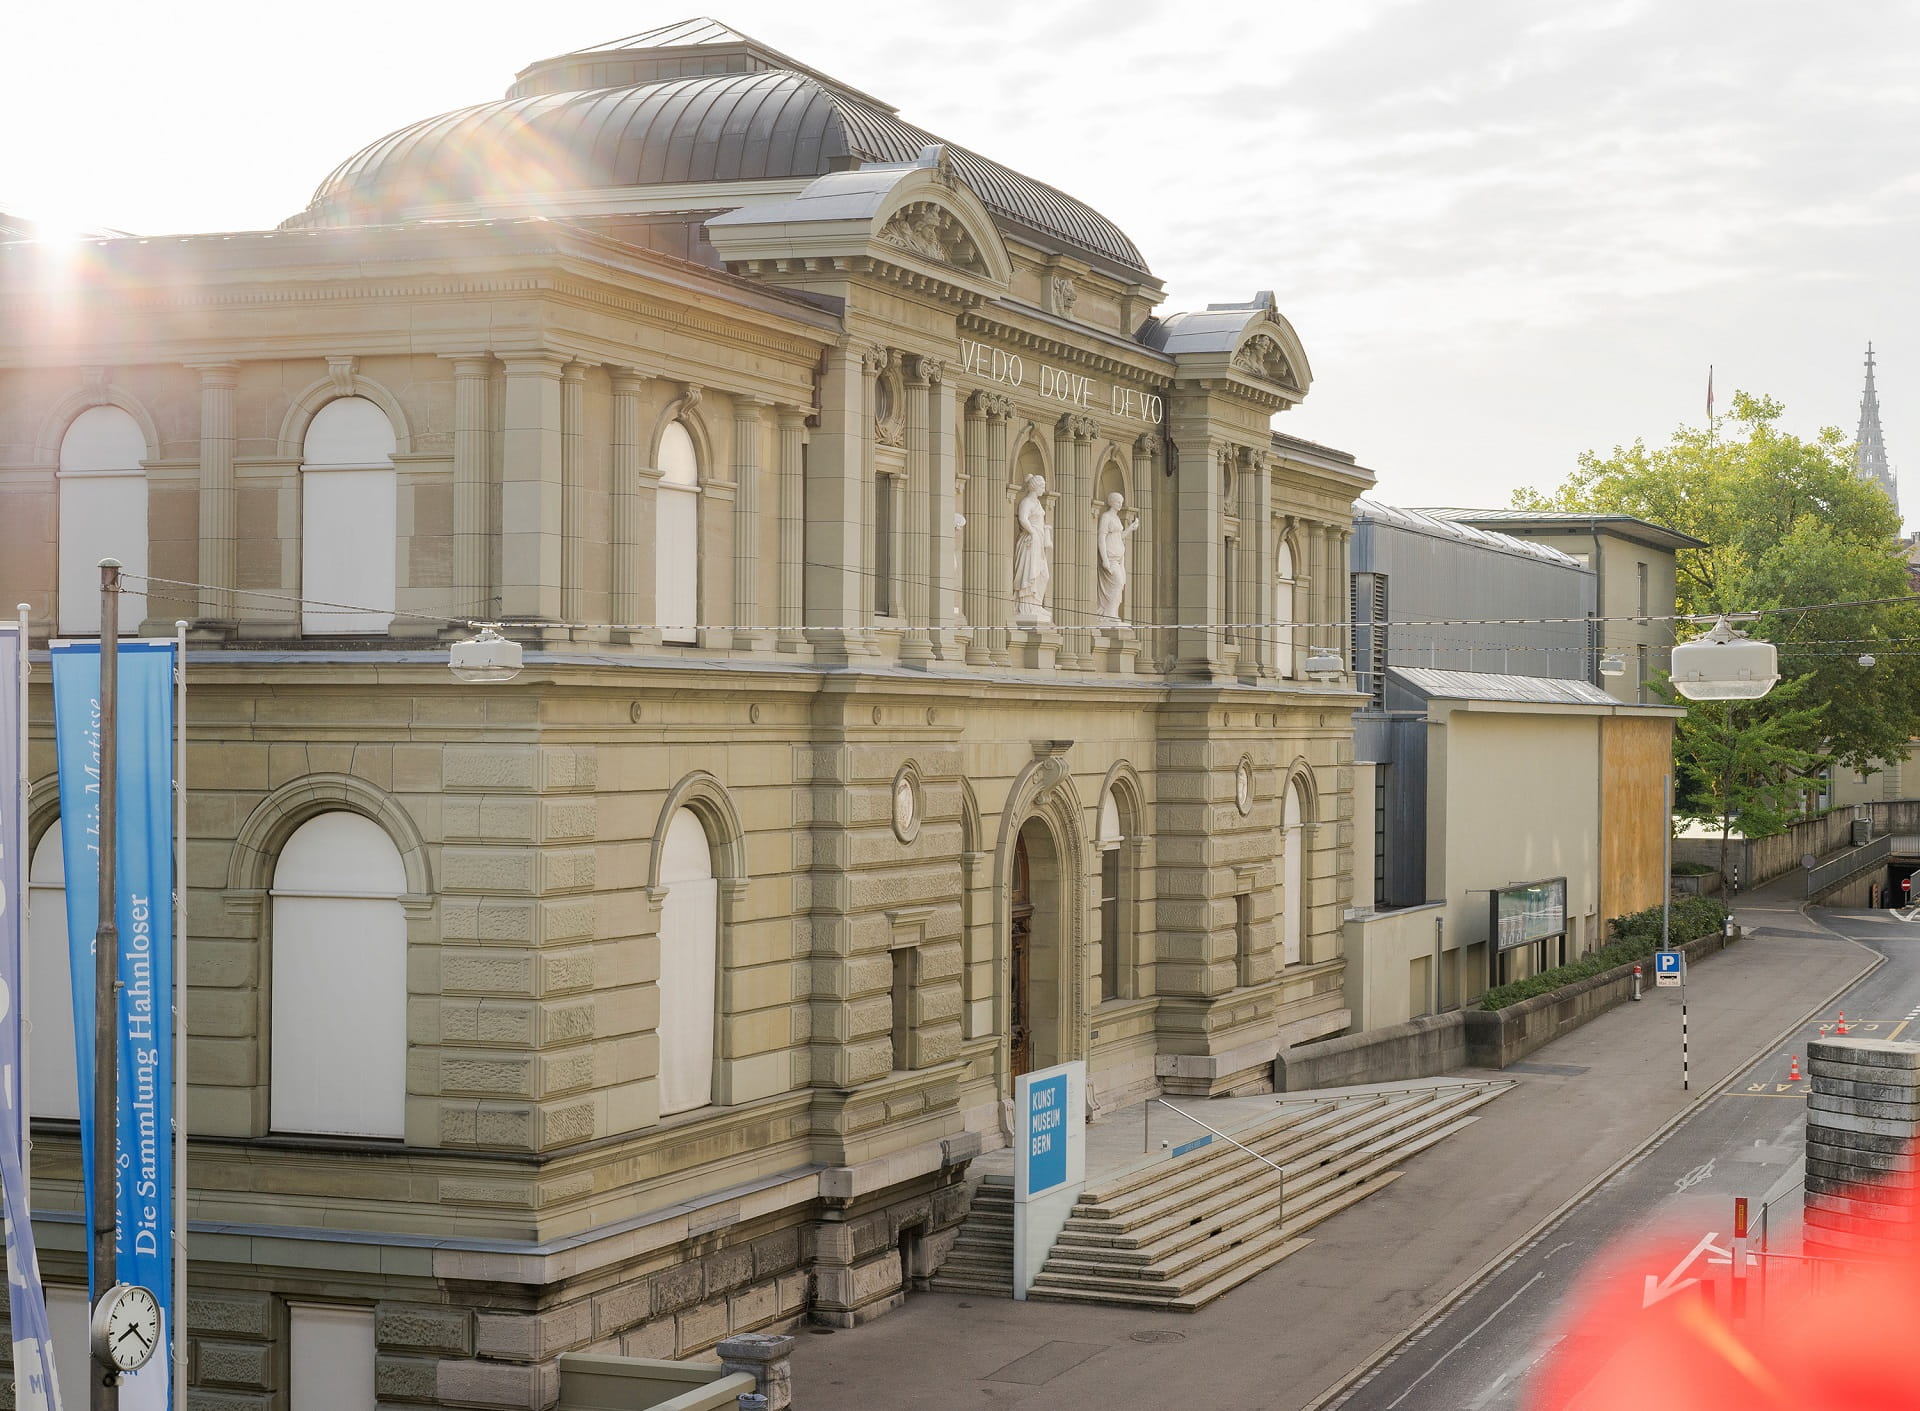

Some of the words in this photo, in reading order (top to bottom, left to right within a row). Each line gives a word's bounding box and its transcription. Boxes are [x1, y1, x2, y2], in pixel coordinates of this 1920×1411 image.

[961, 338, 1023, 387] VEDO
[1039, 363, 1097, 409] DOVE
[1111, 384, 1163, 425] DEVO
[126, 893, 152, 1041] Hahnloser
[1662, 955, 1675, 971] P
[1032, 1087, 1056, 1112] KUNST
[132, 1047, 159, 1198] Sammlung
[1032, 1107, 1060, 1134] MUSEUM
[1032, 1132, 1051, 1157] BERN
[135, 1205, 157, 1259] Die
